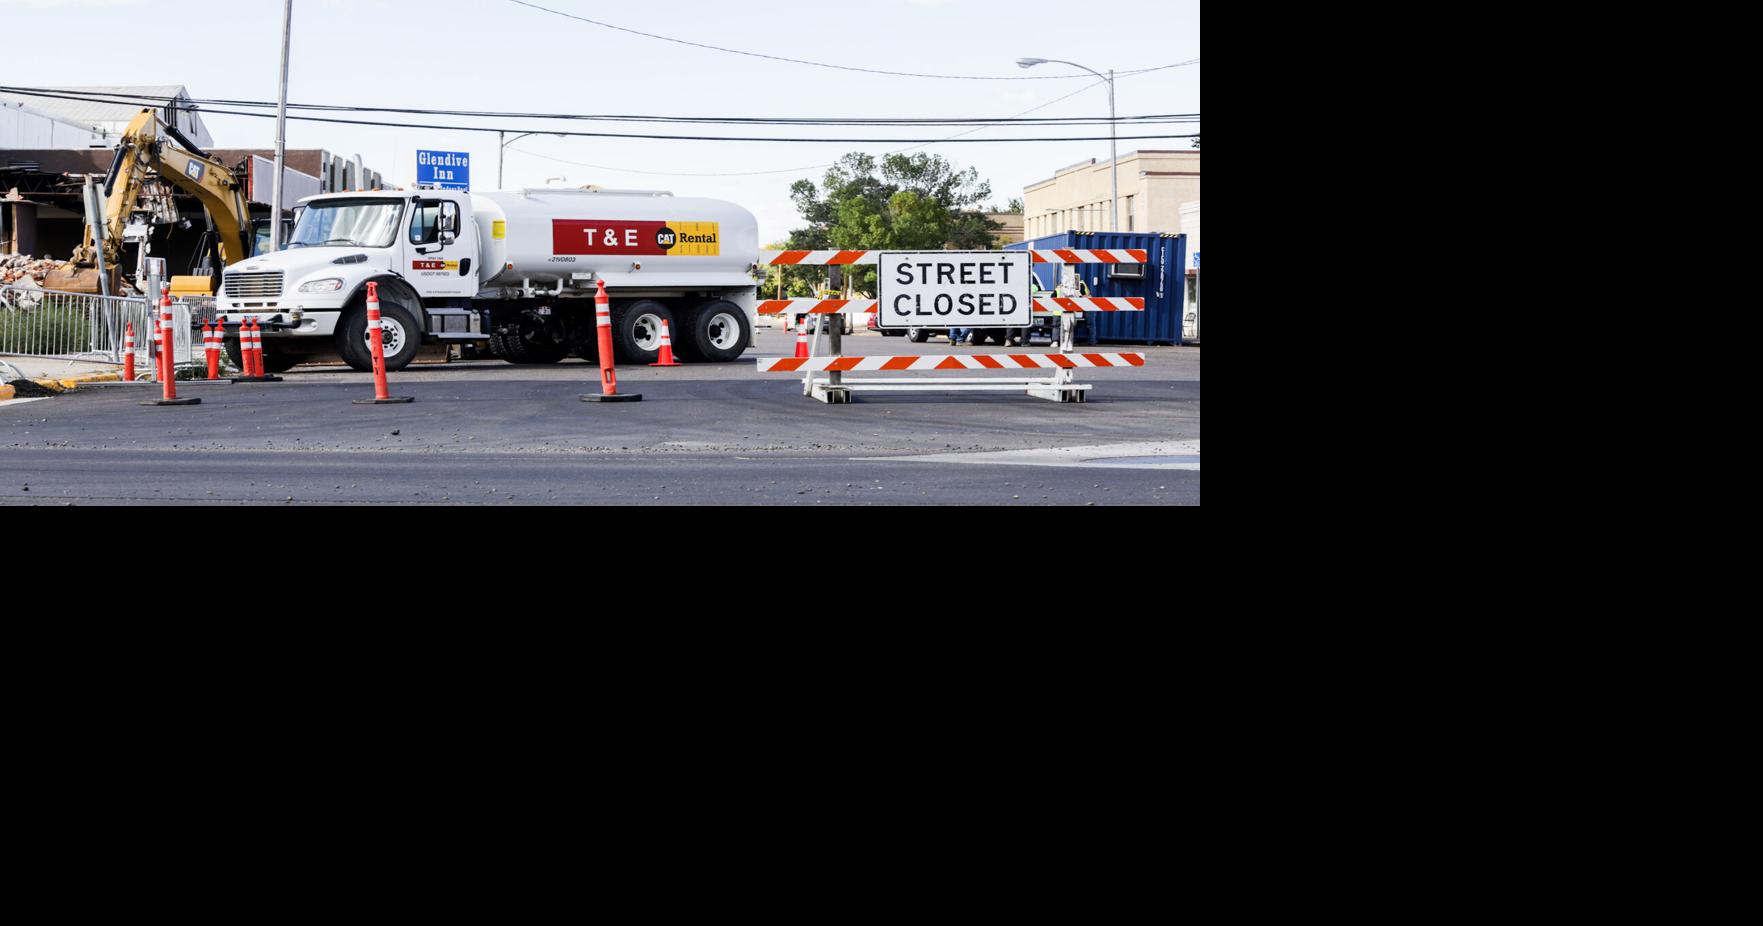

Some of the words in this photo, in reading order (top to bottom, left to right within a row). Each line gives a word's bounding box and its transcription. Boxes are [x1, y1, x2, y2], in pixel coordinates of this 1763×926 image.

[418, 151, 468, 167] Glendive
[188, 162, 200, 179] CAT
[433, 166, 454, 180] Inn
[583, 228, 597, 246] T
[603, 228, 618, 246] &
[624, 229, 638, 246] E
[657, 233, 674, 245] CAT
[679, 232, 717, 243] Rental
[895, 262, 1014, 285] STREET
[893, 293, 1017, 317] CLOSED
